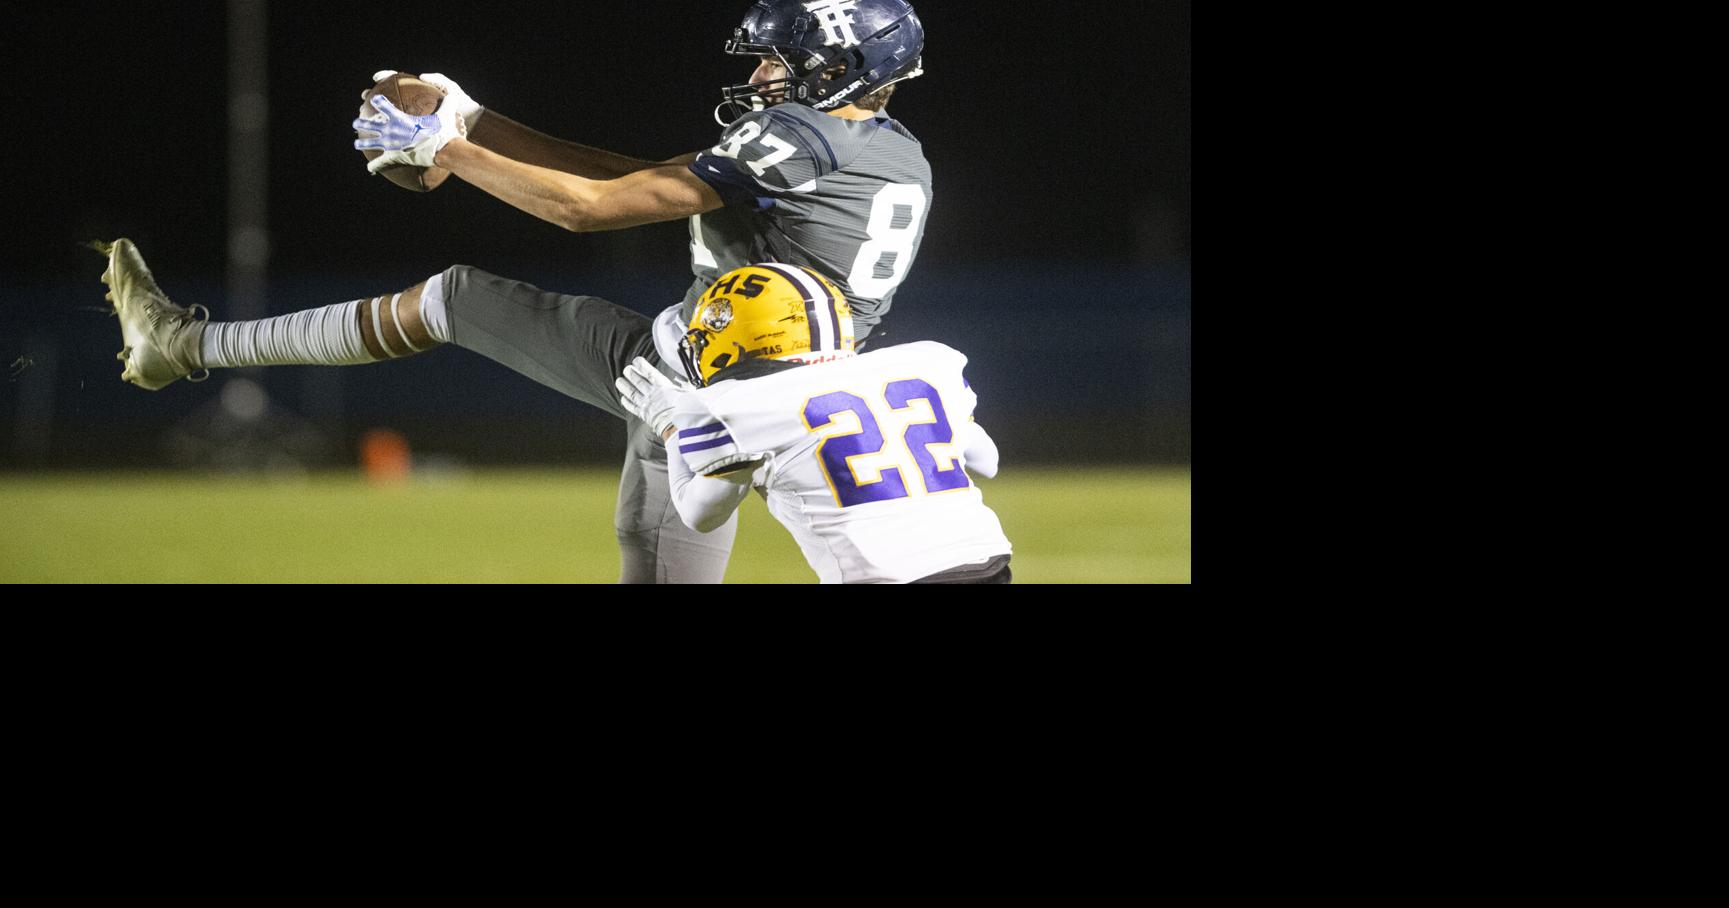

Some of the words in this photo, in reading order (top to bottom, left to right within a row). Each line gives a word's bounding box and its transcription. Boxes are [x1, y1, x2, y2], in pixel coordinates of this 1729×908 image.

[711, 120, 798, 177] 87
[703, 274, 771, 302] HS
[799, 378, 970, 508] 22
